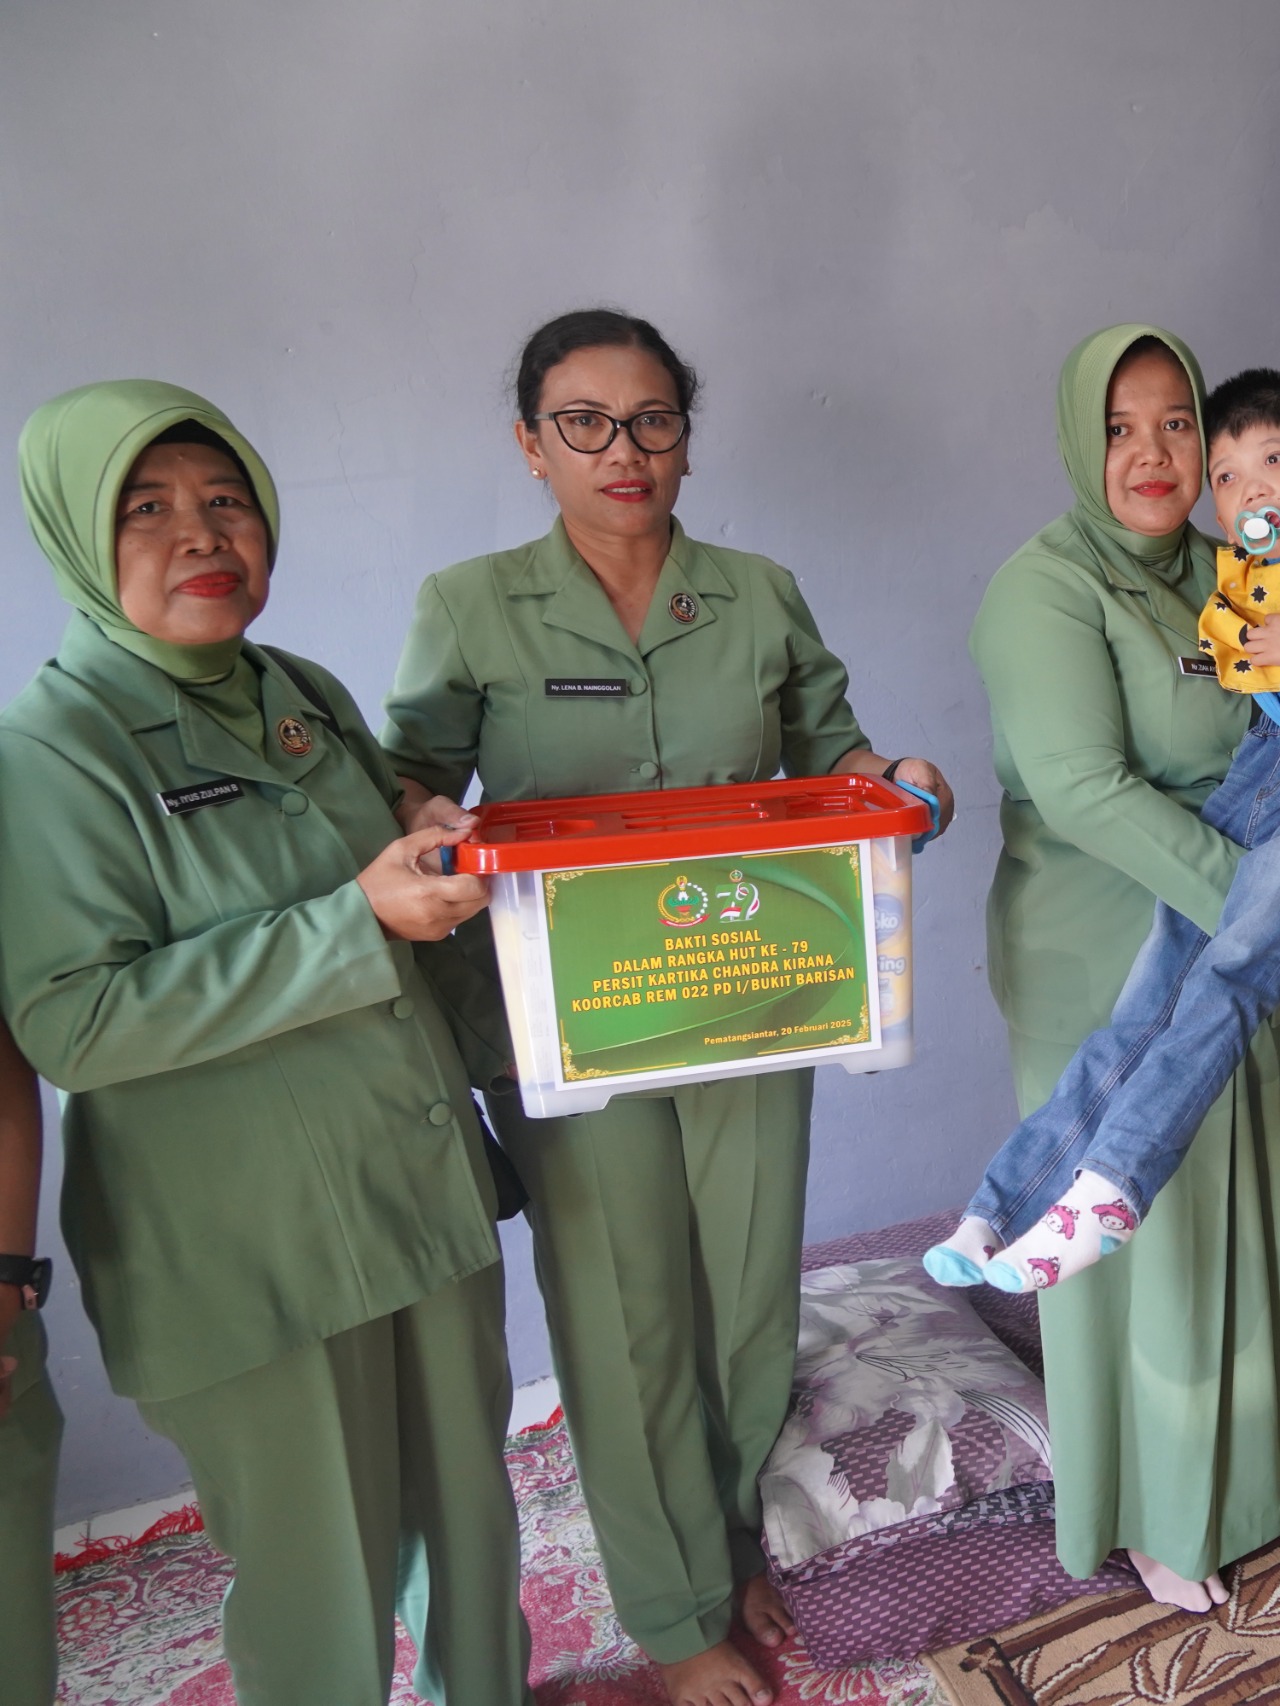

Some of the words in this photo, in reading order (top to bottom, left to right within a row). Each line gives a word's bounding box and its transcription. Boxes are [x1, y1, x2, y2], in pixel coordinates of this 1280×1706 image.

[612, 956, 662, 974] DALAM
[668, 950, 725, 968] RANGKA
[729, 946, 756, 960] HUT
[760, 944, 778, 957] KE
[792, 940, 808, 954] 79
[664, 935, 706, 950] BAKTI
[711, 930, 762, 946] SOSIAL
[572, 992, 642, 1012] KOORCAB
[646, 988, 677, 1003] REM
[682, 984, 708, 999] 022
[713, 982, 732, 996] PD
[736, 975, 792, 994] I/BUKIT
[796, 967, 854, 986] BARISAN
[592, 976, 644, 992] PERSIT
[648, 968, 708, 986] KARTIKA
[712, 960, 779, 979] CHANDRA
[783, 954, 834, 971] KIRANA
[704, 1030, 779, 1046] Pematangsiantar,
[781, 1026, 792, 1036] 20
[794, 1022, 828, 1034] Februari
[830, 1018, 852, 1028] 2025
